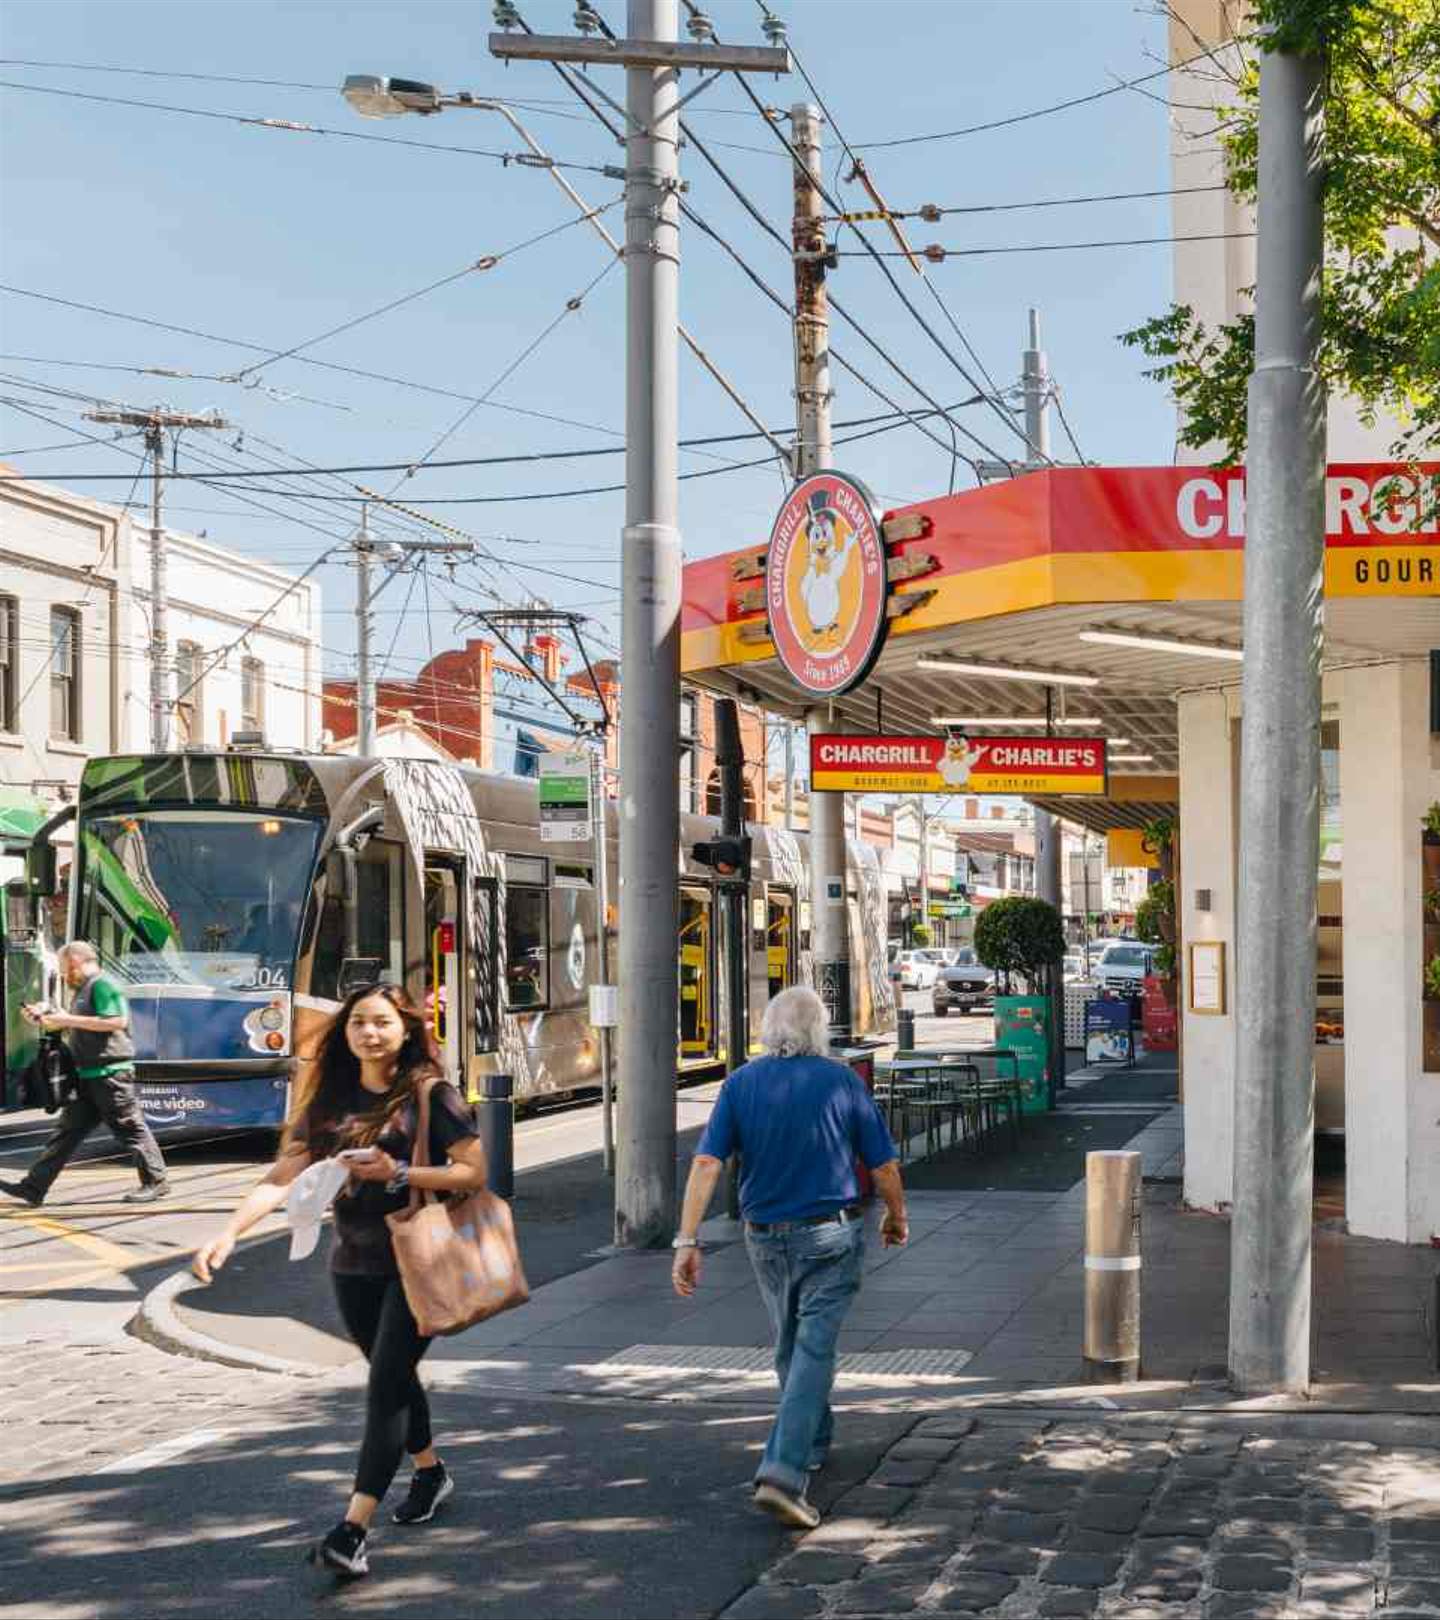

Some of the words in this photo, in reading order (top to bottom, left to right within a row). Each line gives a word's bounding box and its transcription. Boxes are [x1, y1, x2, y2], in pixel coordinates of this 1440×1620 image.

[769, 503, 801, 607] CHARGRILL
[836, 487, 878, 576] CHARLIE'S
[820, 744, 932, 765] CHARGRILL
[991, 746, 1096, 768] CHARLIE'S
[163, 1096, 205, 1110] video
